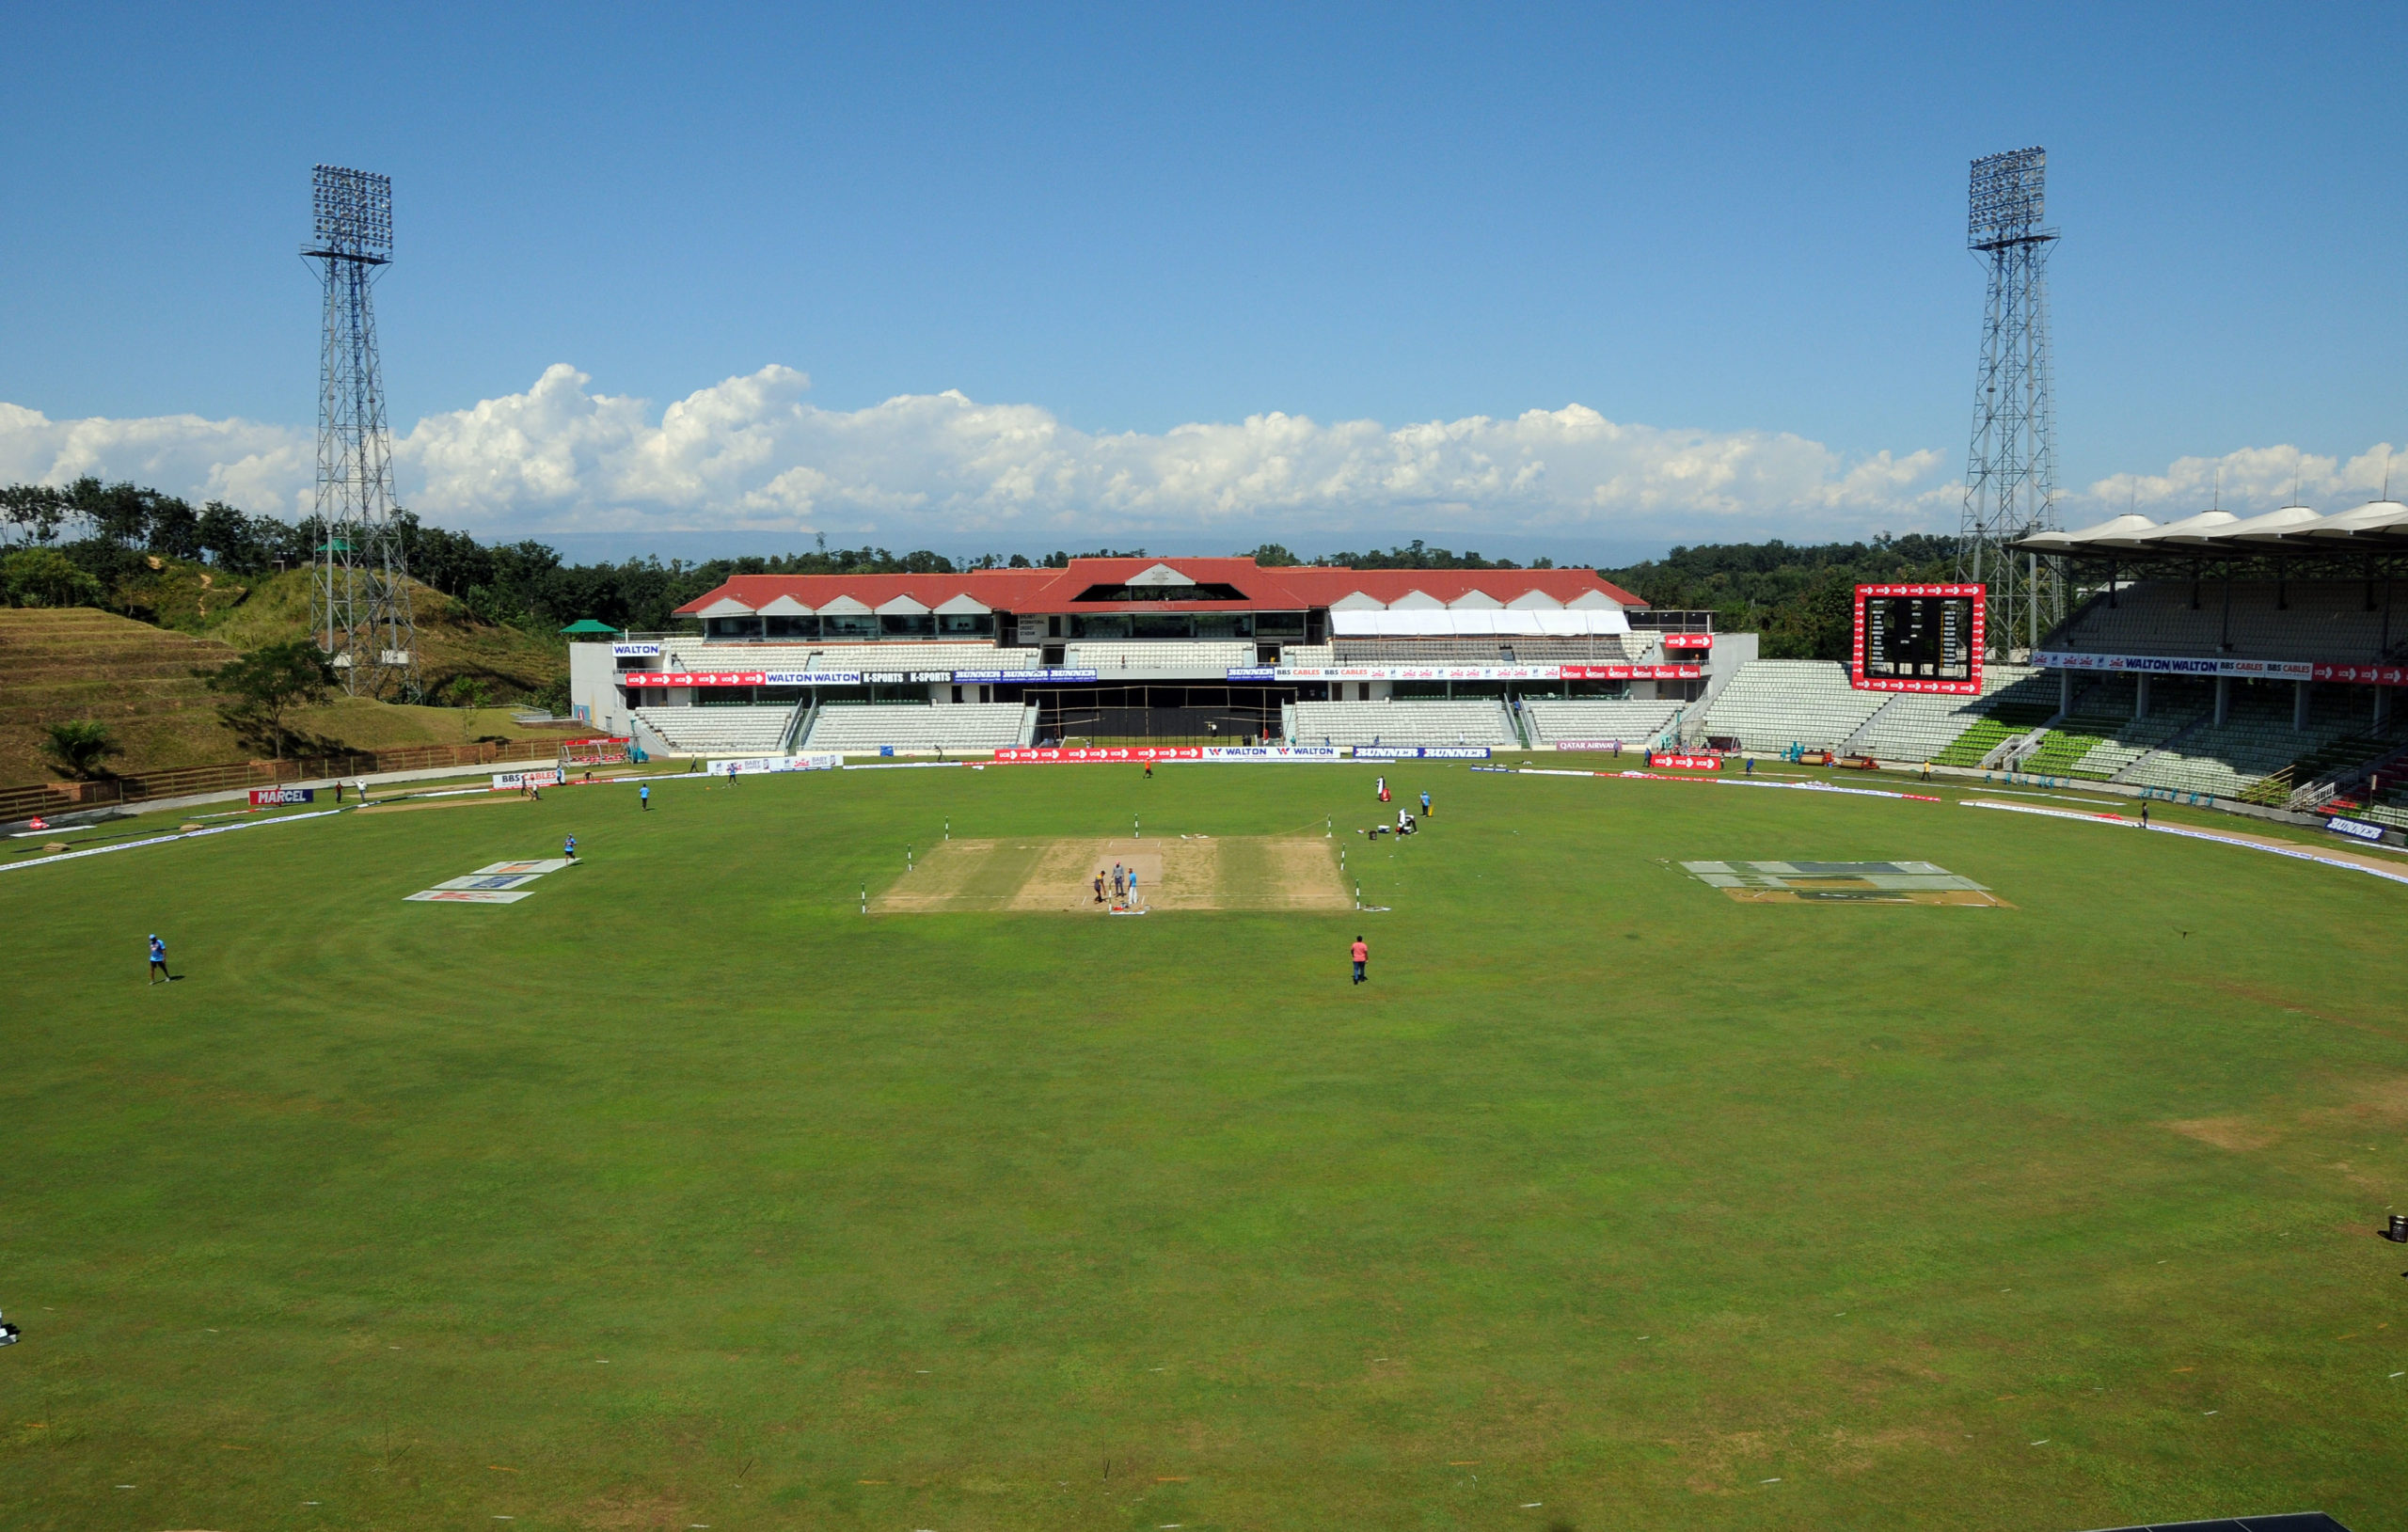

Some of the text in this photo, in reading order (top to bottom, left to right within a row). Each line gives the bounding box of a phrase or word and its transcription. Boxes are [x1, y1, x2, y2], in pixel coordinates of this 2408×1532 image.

[2126, 658, 2170, 670] WALTON
[2172, 660, 2217, 671] WALTON
[2283, 665, 2310, 673] CABLES
[767, 673, 859, 682] WALTON WALTON
[863, 673, 903, 682] K-SPORTS
[911, 673, 951, 681] K-SPORTS
[1355, 747, 1488, 757] RUNNER RUNNER
[502, 772, 556, 782] BBS CABLES
[258, 791, 306, 803] MARCEL
[2327, 817, 2382, 839] RUNNER
